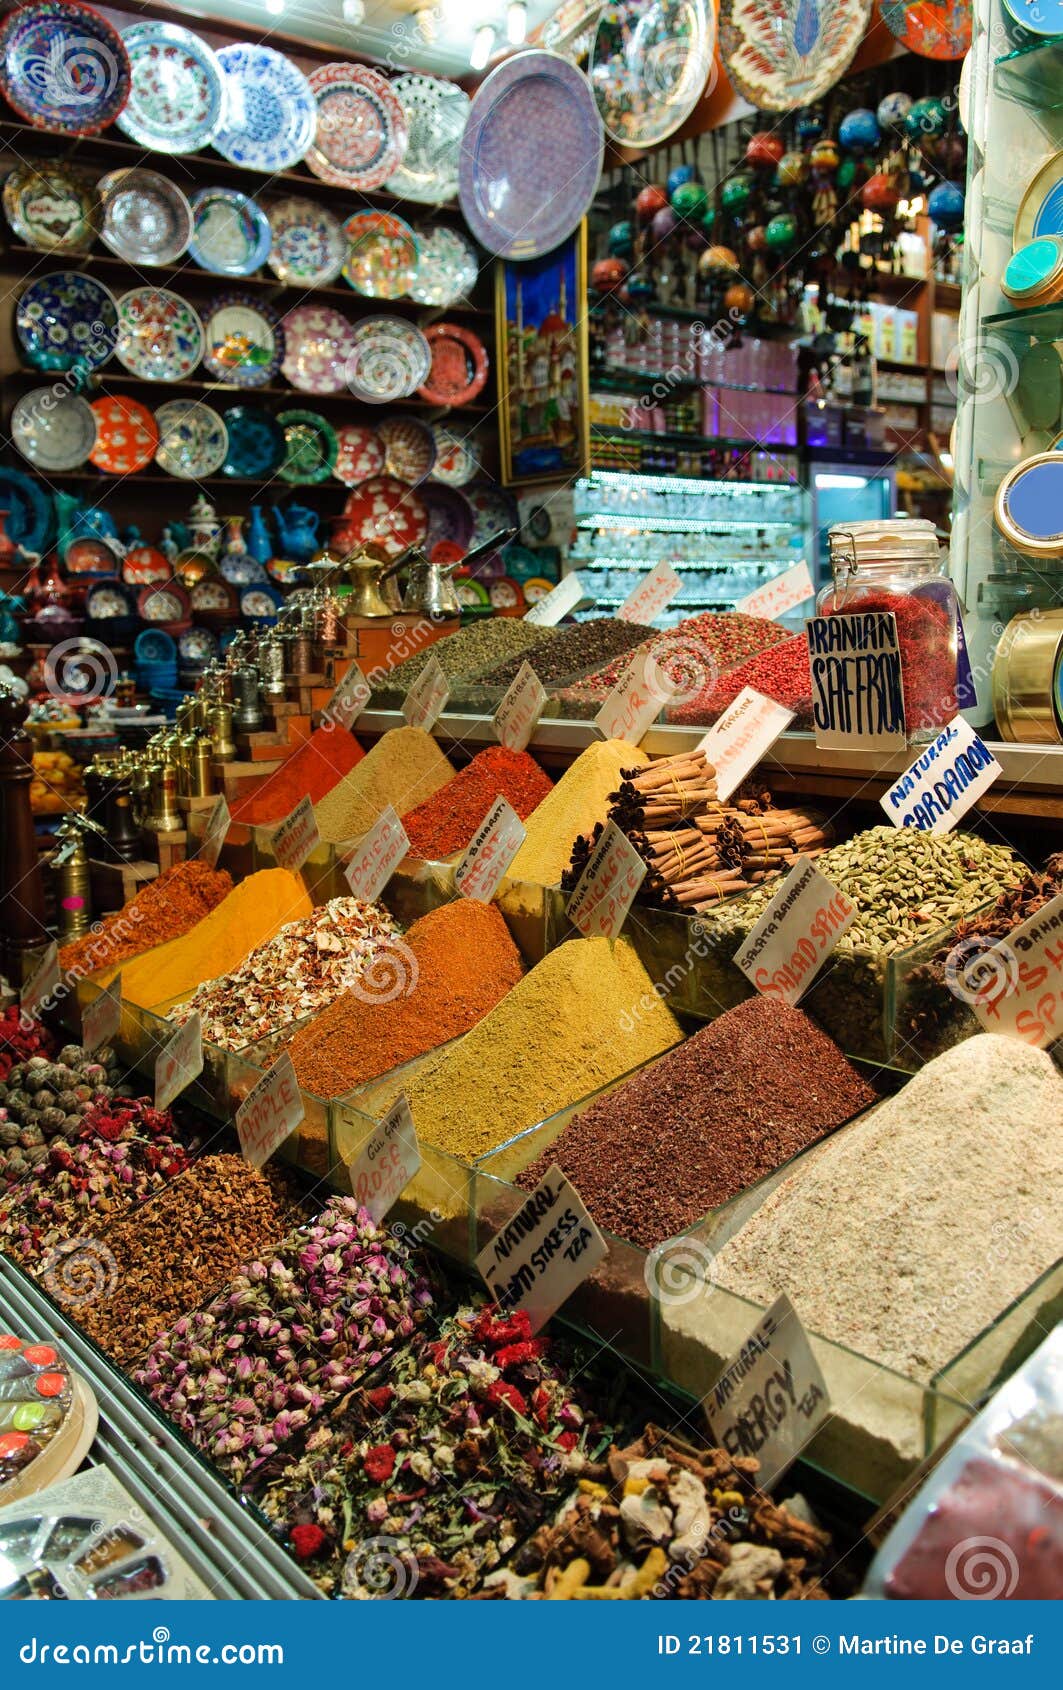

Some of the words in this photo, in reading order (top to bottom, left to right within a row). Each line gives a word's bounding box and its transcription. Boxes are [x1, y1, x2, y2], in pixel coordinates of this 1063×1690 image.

[807, 614, 896, 655] IRANIAN
[812, 651, 905, 735] SAFFRON
[889, 726, 959, 808] NATURAL
[740, 922, 779, 971] SALATA
[809, 890, 854, 949] SPICE
[754, 937, 819, 1001] SALAD
[563, 1226, 594, 1263] TEA
